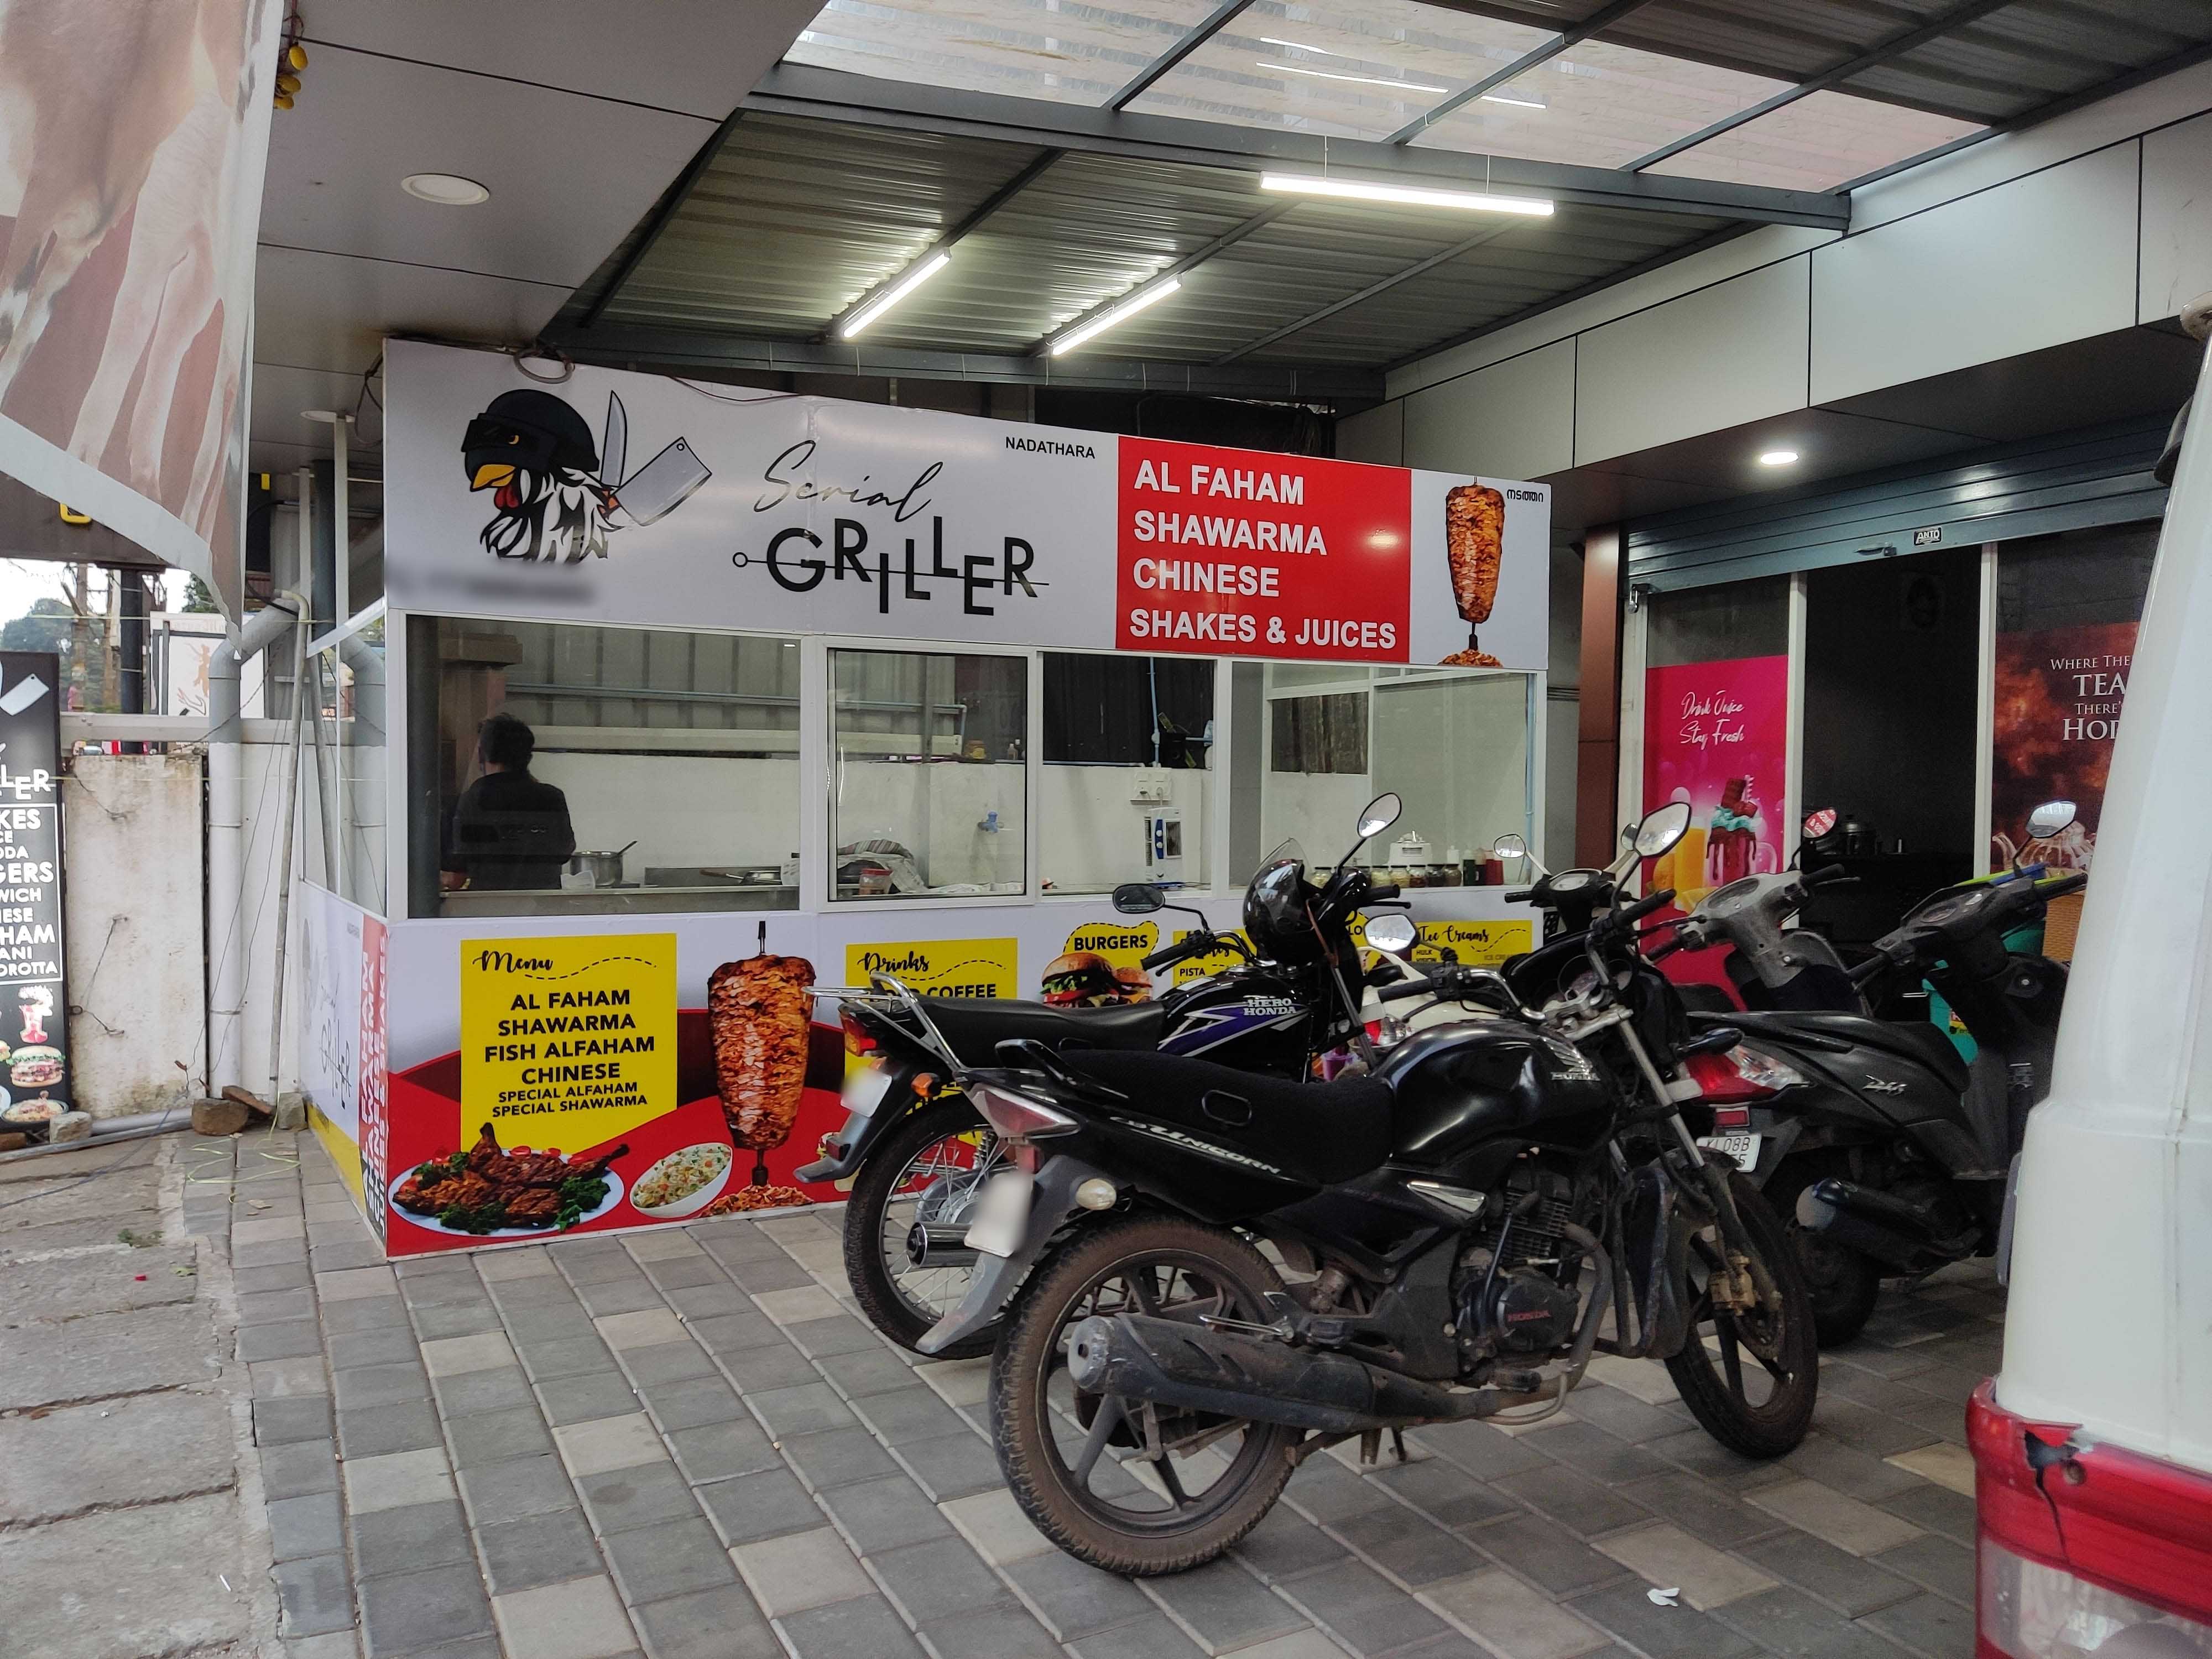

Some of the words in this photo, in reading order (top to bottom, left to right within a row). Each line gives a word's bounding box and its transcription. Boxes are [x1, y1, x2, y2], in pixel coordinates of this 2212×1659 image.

[1005, 436, 1095, 459] NADATHARA
[753, 440, 943, 522] Serial
[1134, 460, 1180, 493] AL
[1190, 465, 1305, 505] FAHAM
[1506, 489, 1544, 502] നടത്തറ
[1134, 510, 1327, 556] SHAWARMA
[766, 516, 1038, 616] GRILLER
[1133, 558, 1280, 598] CHINESE
[1130, 608, 1257, 643] SHAKES
[1266, 616, 1287, 645] &
[1295, 619, 1397, 650] JUICES
[2050, 658, 2099, 670] WHERE
[2072, 672, 2126, 697] TEA
[1681, 691, 1712, 719] Drink
[1680, 720, 1708, 750] Stay
[1712, 718, 1745, 745] Fresh
[0, 764, 51, 800] LER
[0, 907, 33, 924] ESE
[1074, 934, 1149, 951] BURGERS
[1442, 925, 1489, 942] Creams
[472, 950, 554, 973] Menu
[857, 951, 930, 974] Drinks
[1180, 968, 1206, 977] PISTA
[510, 994, 541, 1011] AL
[548, 989, 630, 1009] FAHAM
[1243, 1006, 1297, 1016] HONDA
[1247, 998, 1292, 1007] HERO
[498, 1014, 635, 1036] SHAWARMA
[484, 1044, 536, 1062] FISH
[544, 1036, 655, 1058] ALFAHAM
[521, 1063, 620, 1085] CHINESE
[498, 1088, 560, 1103] SPECIAL
[566, 1082, 638, 1097] ALFAHAM
[492, 1103, 555, 1117] SPECIAL
[559, 1095, 648, 1113] SHAWARMA
